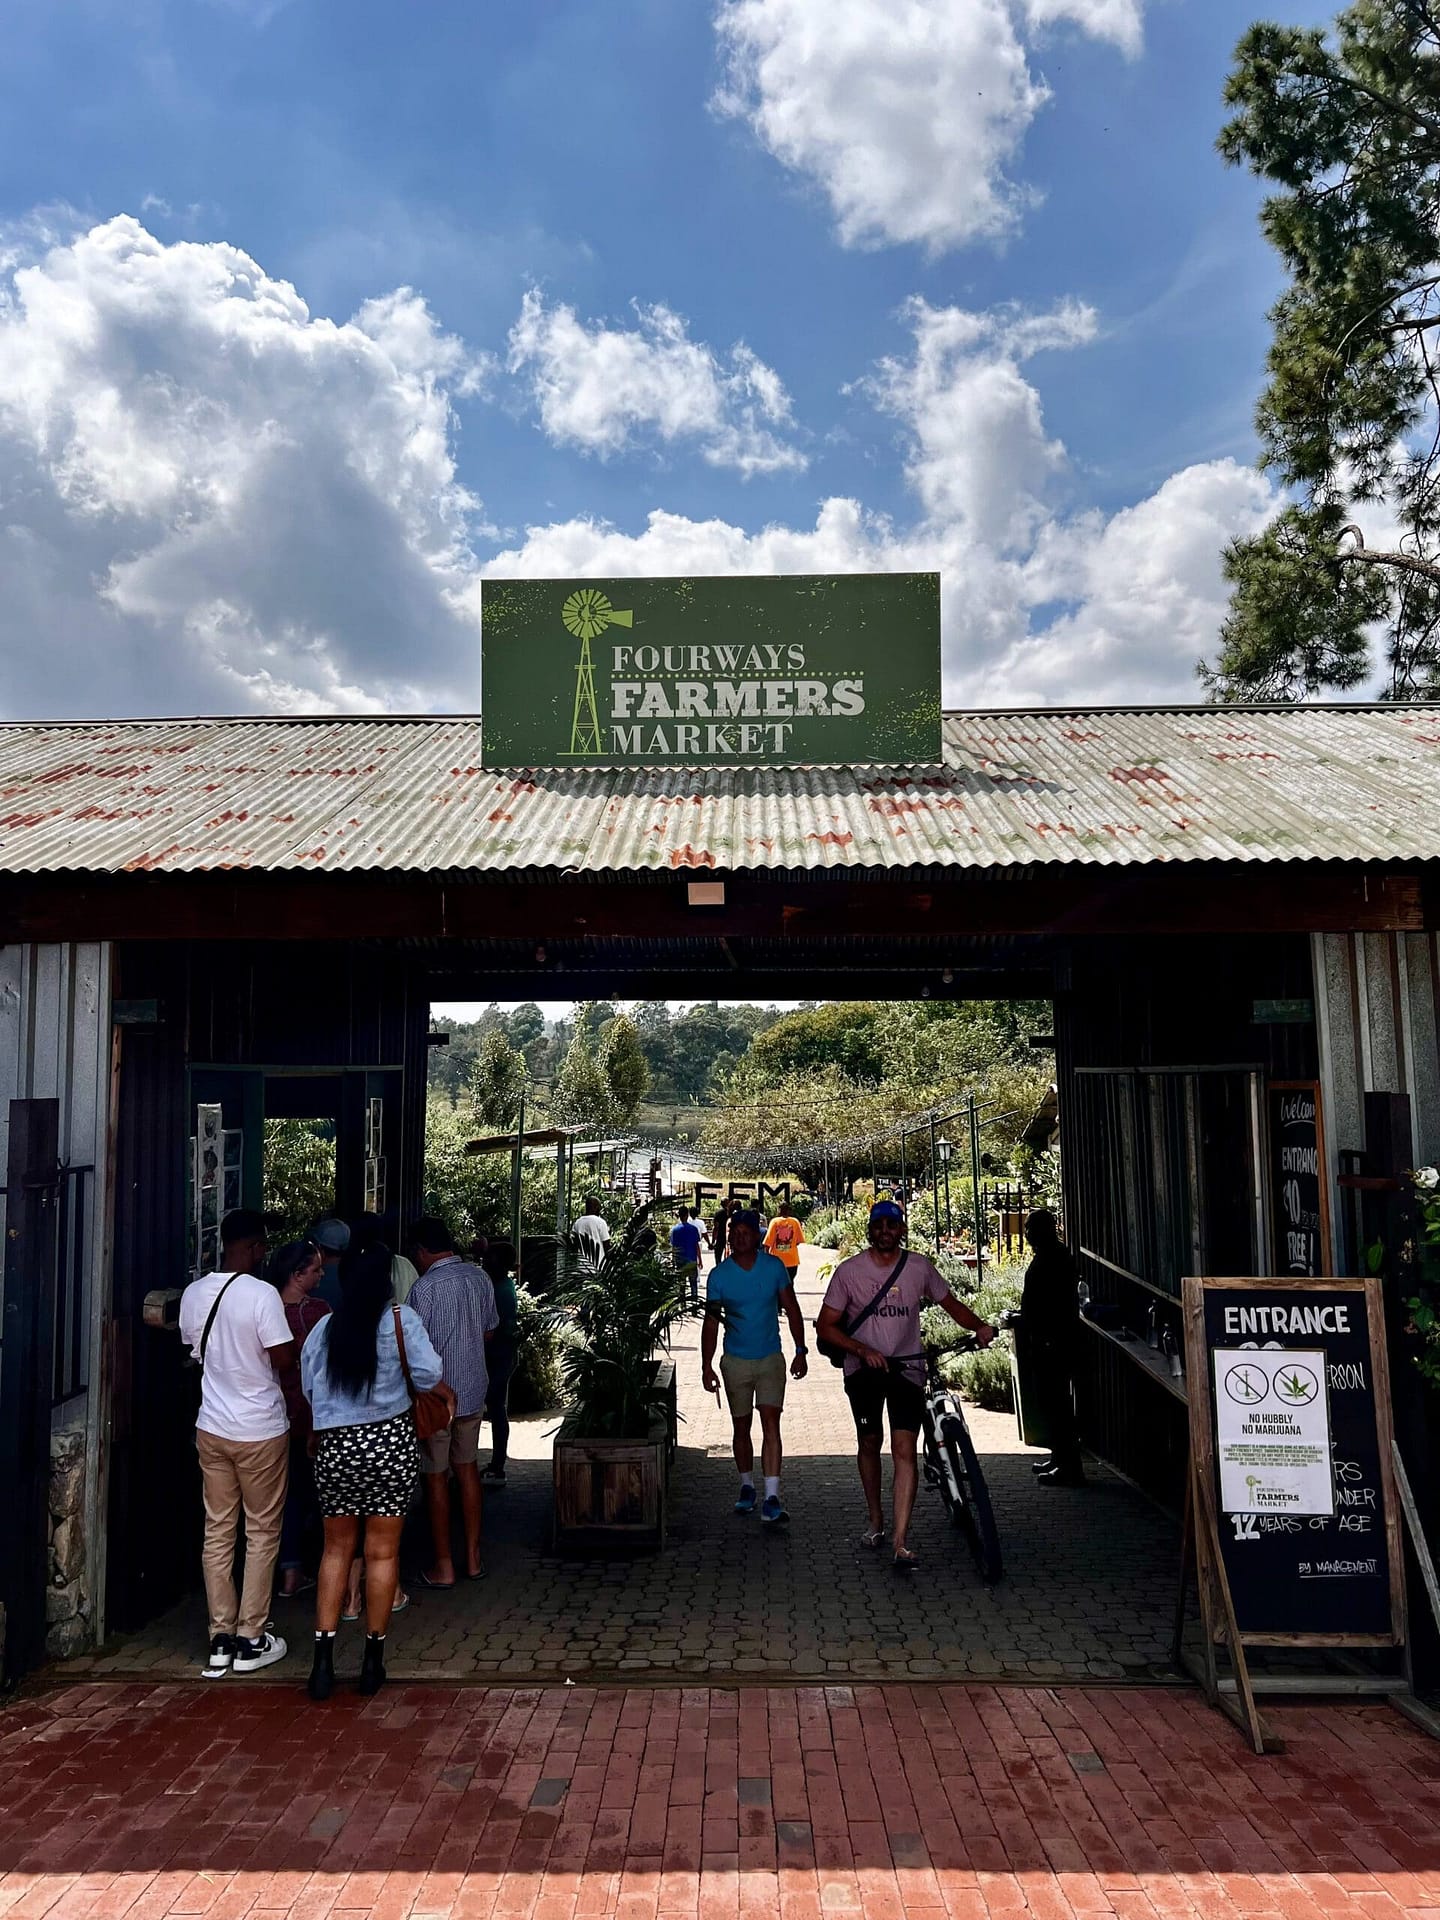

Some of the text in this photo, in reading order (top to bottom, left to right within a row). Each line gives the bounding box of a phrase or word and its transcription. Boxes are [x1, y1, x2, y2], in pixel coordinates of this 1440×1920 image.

[611, 643, 806, 672] FOURWAYS
[611, 679, 866, 718] FARMERS
[611, 724, 795, 755] MARKET
[1281, 1094, 1316, 1121] Welcom
[1282, 1147, 1318, 1176] ENTRANC
[1224, 1306, 1351, 1334] ENTRANCE
[1326, 1362, 1366, 1390] RSON
[1242, 1424, 1302, 1435] NO MARIJUANA
[1249, 1413, 1293, 1425] NO HUBBLY
[1231, 1514, 1372, 1541] 12 YEARS OF AGE
[1298, 1559, 1377, 1574] BY MANAGEMENT
